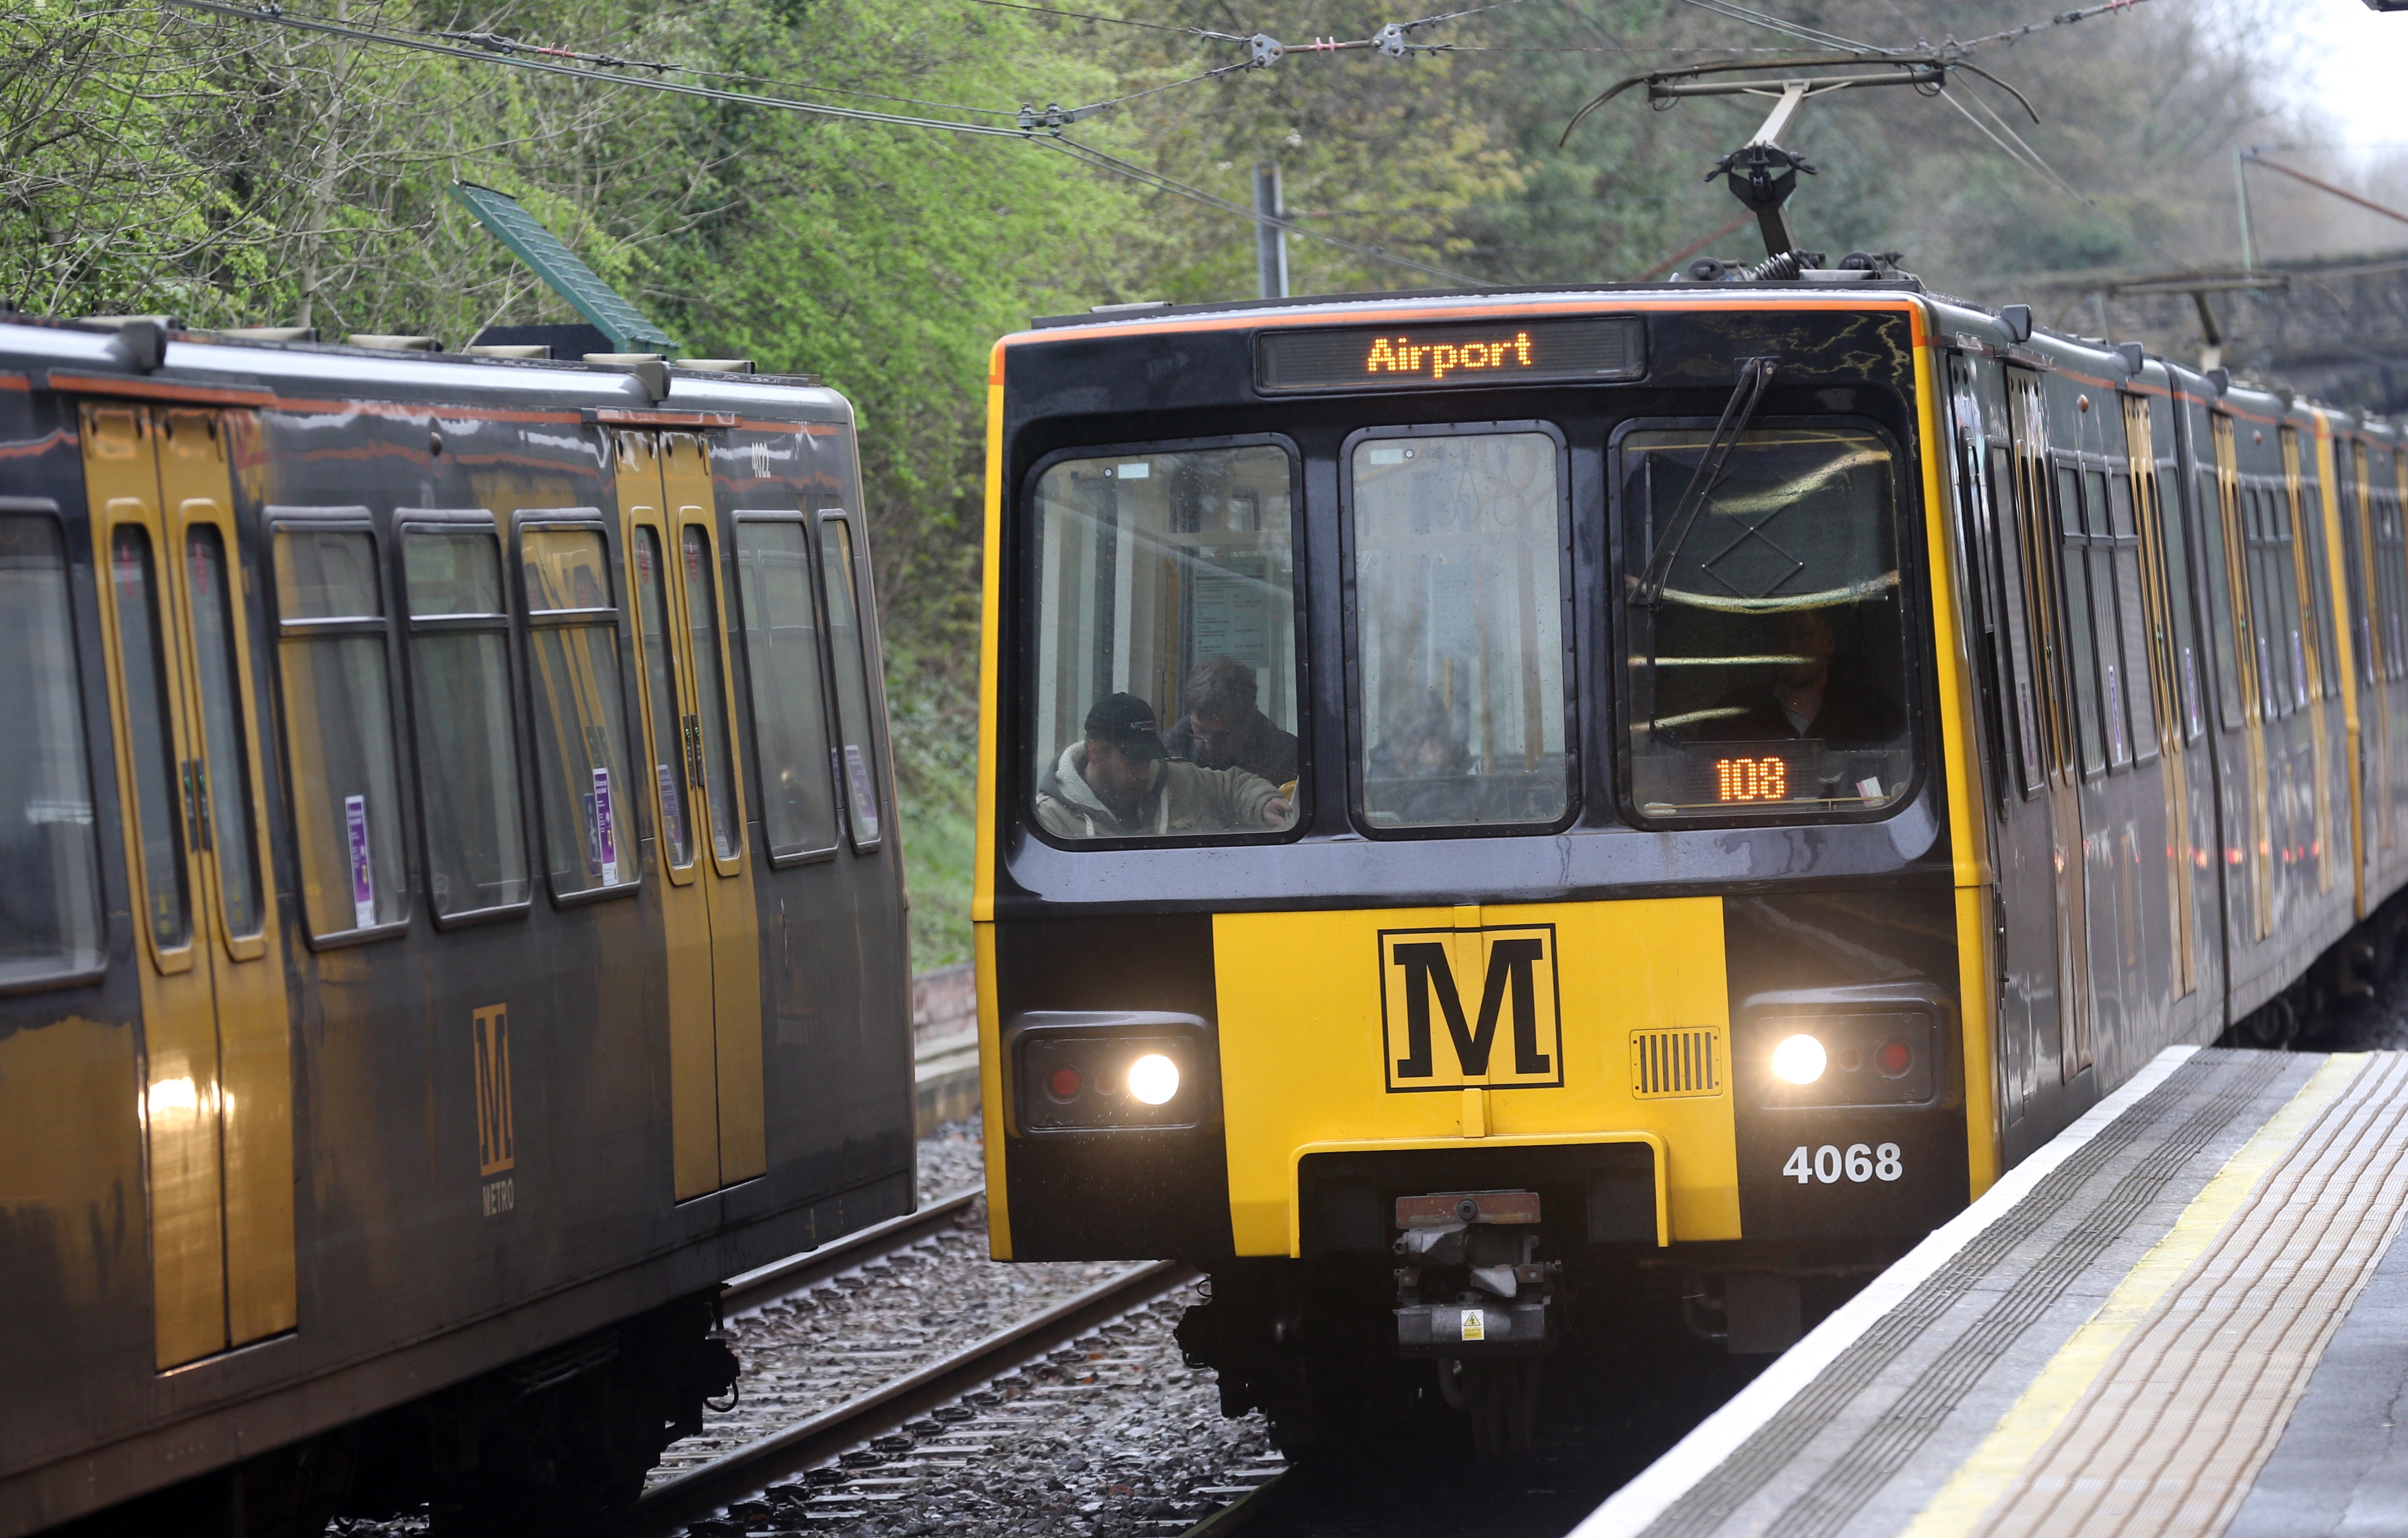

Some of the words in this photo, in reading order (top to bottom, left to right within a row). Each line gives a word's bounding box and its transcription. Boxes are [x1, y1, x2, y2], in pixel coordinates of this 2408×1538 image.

[1368, 332, 1532, 379] Airport
[1716, 757, 1785, 800] 108
[1393, 938, 1550, 1078] M
[475, 1013, 512, 1166] M
[1783, 1142, 1903, 1184] 4068
[482, 1177, 515, 1217] METRO
